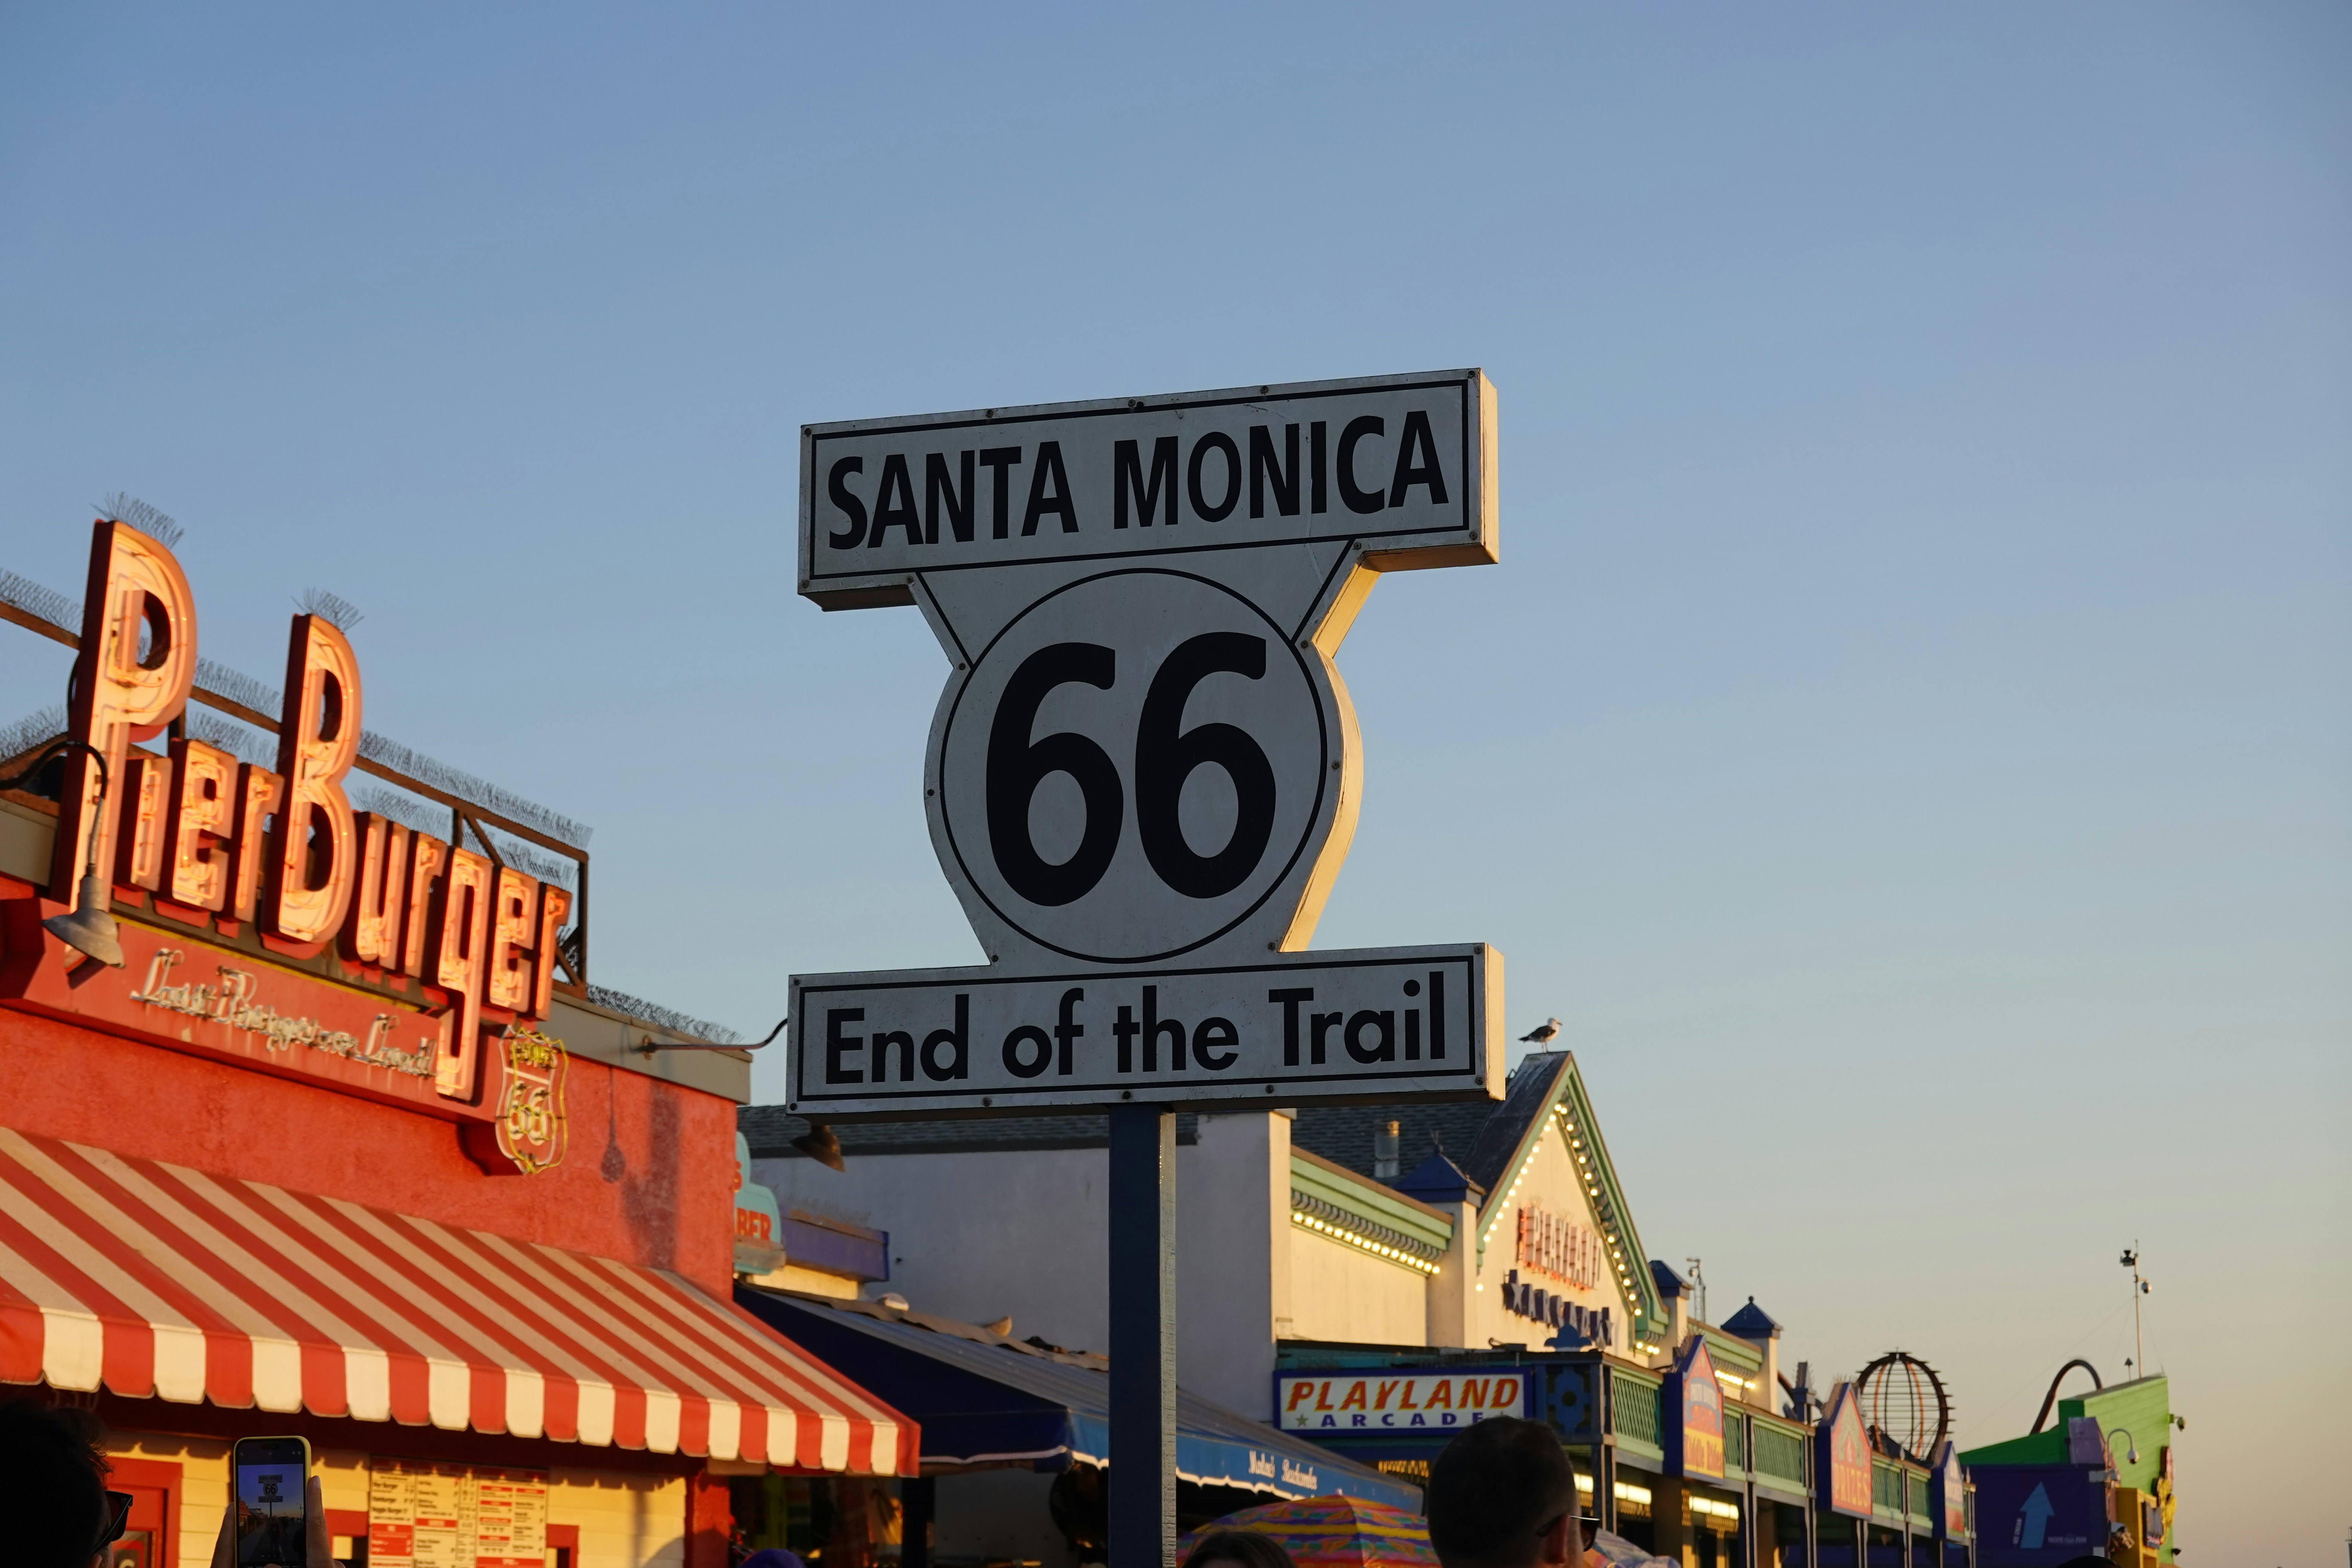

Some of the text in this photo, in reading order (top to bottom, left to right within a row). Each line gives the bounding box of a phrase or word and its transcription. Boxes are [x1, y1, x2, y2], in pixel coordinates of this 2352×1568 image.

[827, 410, 1450, 550] SANTA MONICA
[985, 631, 1277, 908] 66
[52, 520, 571, 1101] Pier Burger
[824, 970, 1446, 1085] End of the Trail
[504, 1080, 556, 1146] 66
[1286, 1378, 1519, 1412] PLAYLAND
[1320, 1412, 1485, 1427] ARCADE
[265, 1483, 276, 1494] 66
[1833, 1462, 1869, 1508] PRIZES
